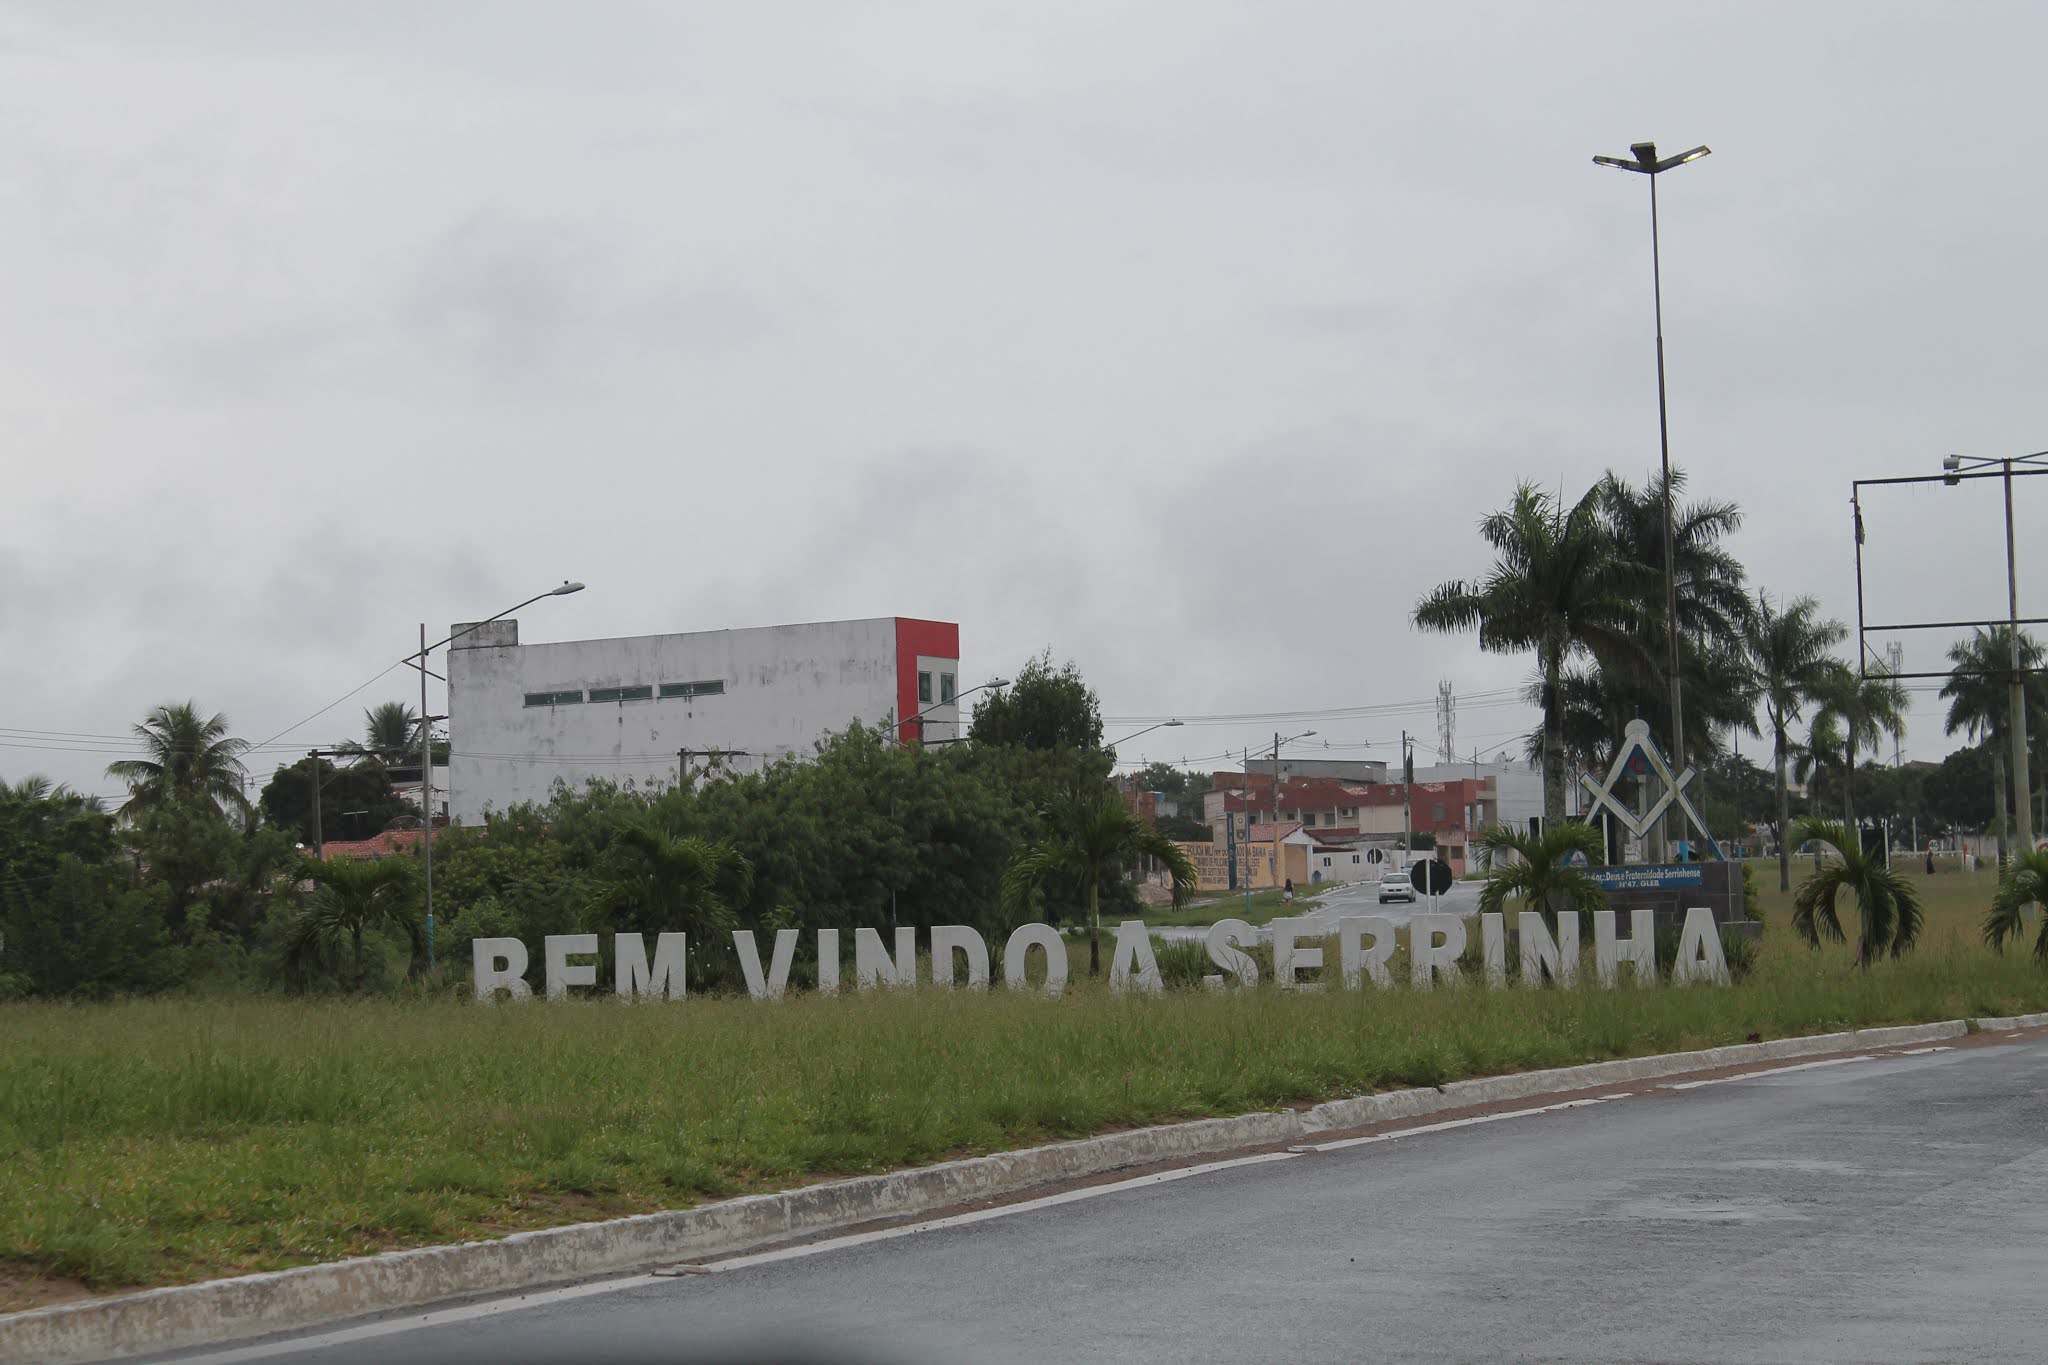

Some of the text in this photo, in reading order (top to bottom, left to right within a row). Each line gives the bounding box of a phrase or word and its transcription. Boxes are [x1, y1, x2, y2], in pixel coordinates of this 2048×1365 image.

[1625, 868, 1664, 880] Fraternidade
[1664, 867, 1701, 878] Serrinhense
[472, 907, 1732, 1000] BEM VINDO A SERRINHA
